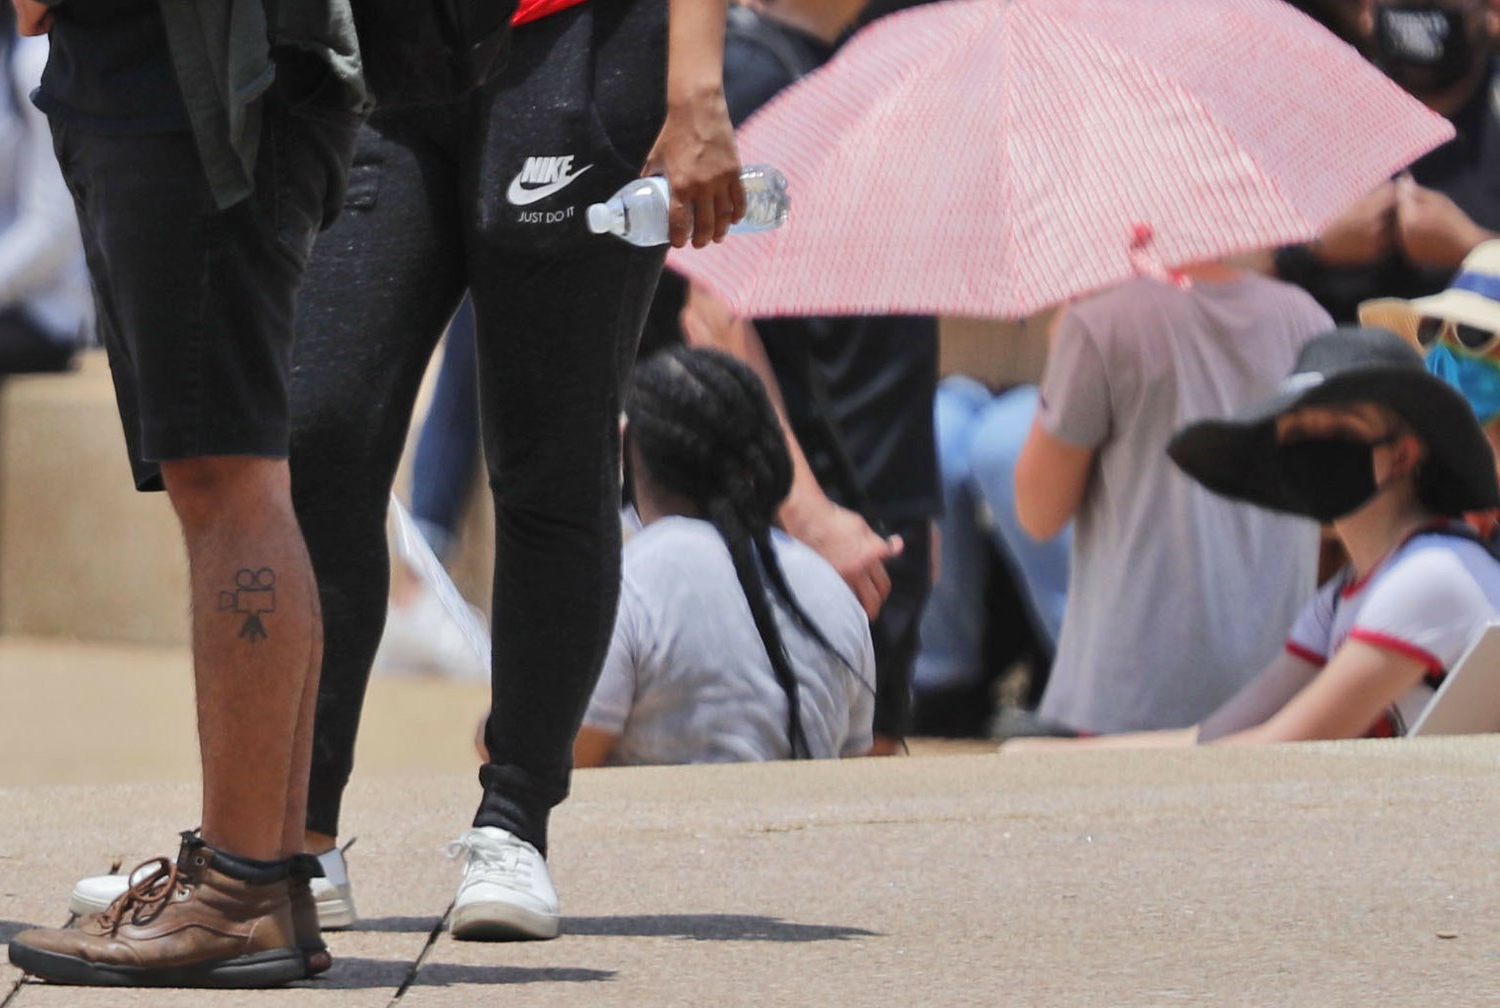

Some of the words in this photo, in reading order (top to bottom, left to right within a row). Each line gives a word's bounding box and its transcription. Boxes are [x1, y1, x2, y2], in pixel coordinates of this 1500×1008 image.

[520, 155, 575, 184] NIKE
[518, 211, 543, 224] JUST
[546, 210, 565, 223] DO
[566, 206, 575, 218] IT
